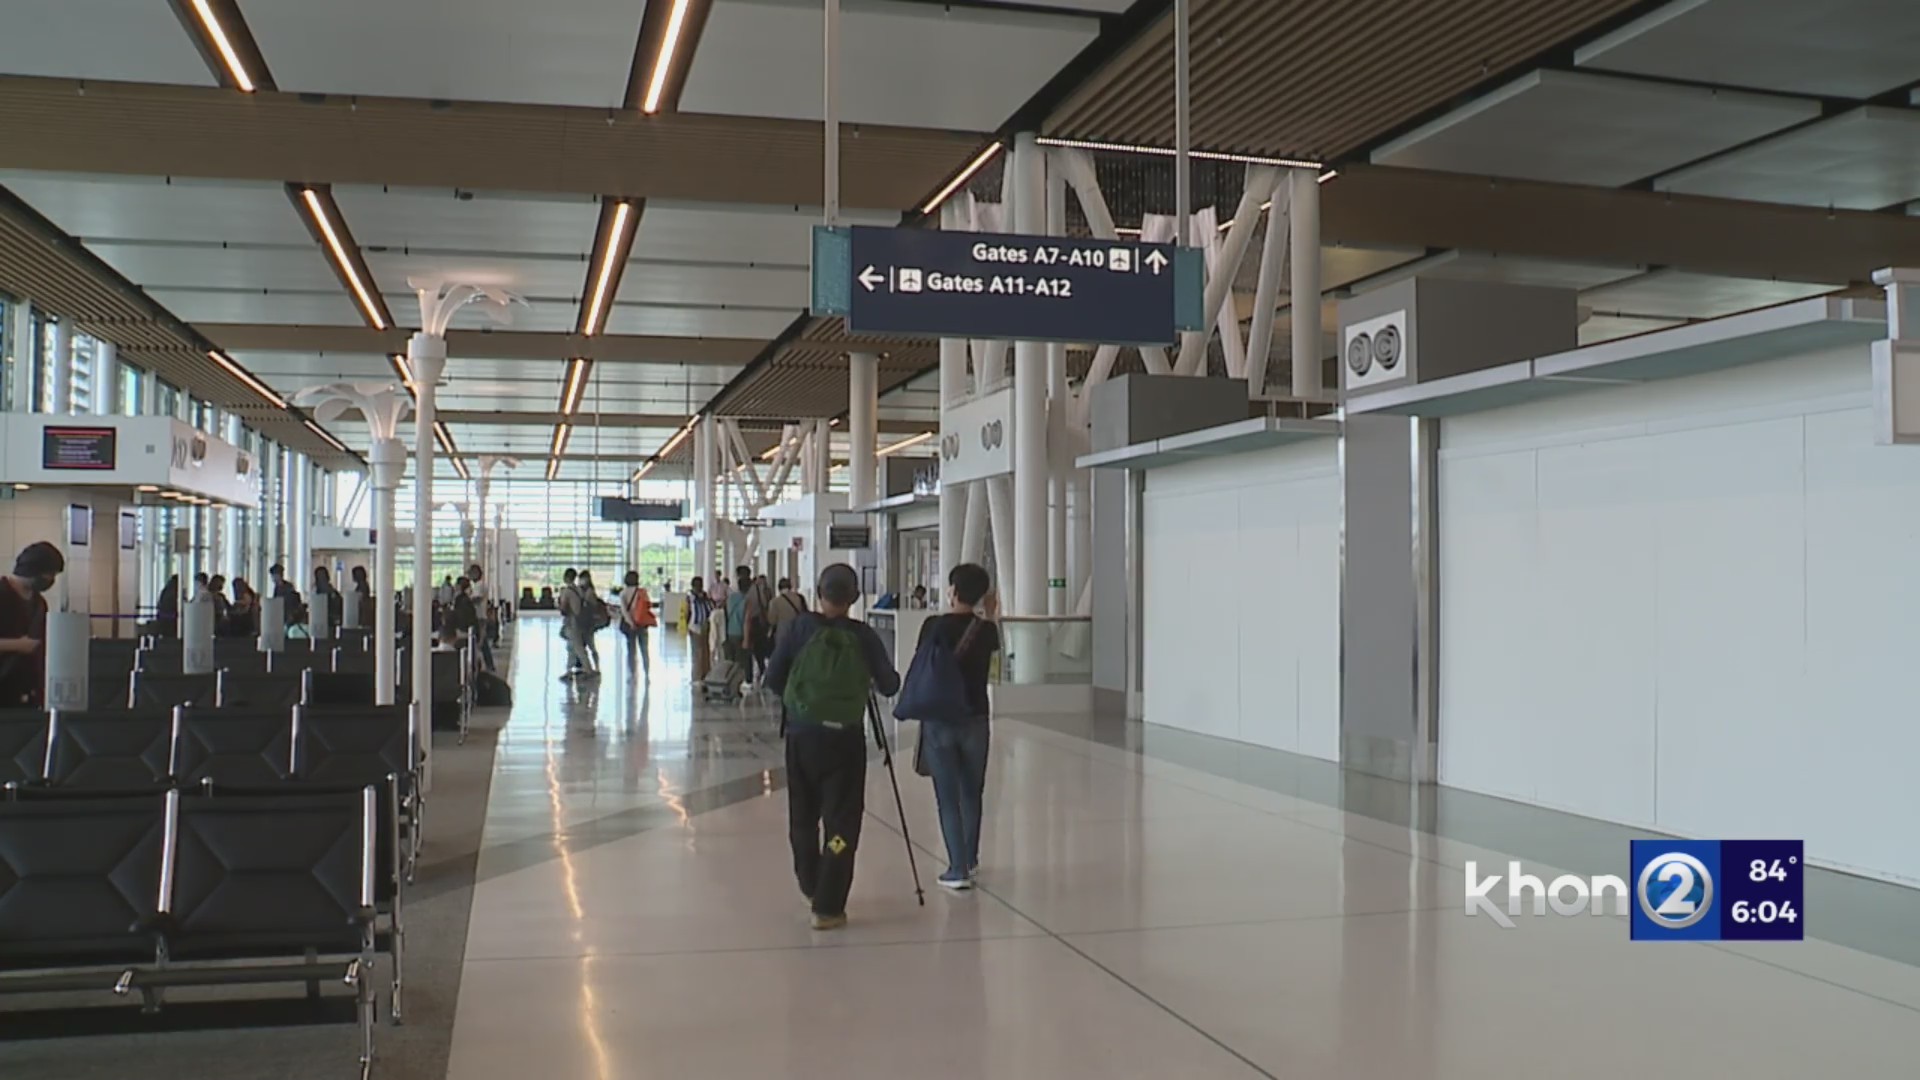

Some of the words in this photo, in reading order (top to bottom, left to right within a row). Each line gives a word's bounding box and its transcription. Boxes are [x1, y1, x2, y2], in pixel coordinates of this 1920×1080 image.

[972, 242, 1028, 263] Gates
[1033, 246, 1105, 267] A7-A10
[927, 271, 984, 293] Gates
[989, 275, 1072, 297] A11-A12
